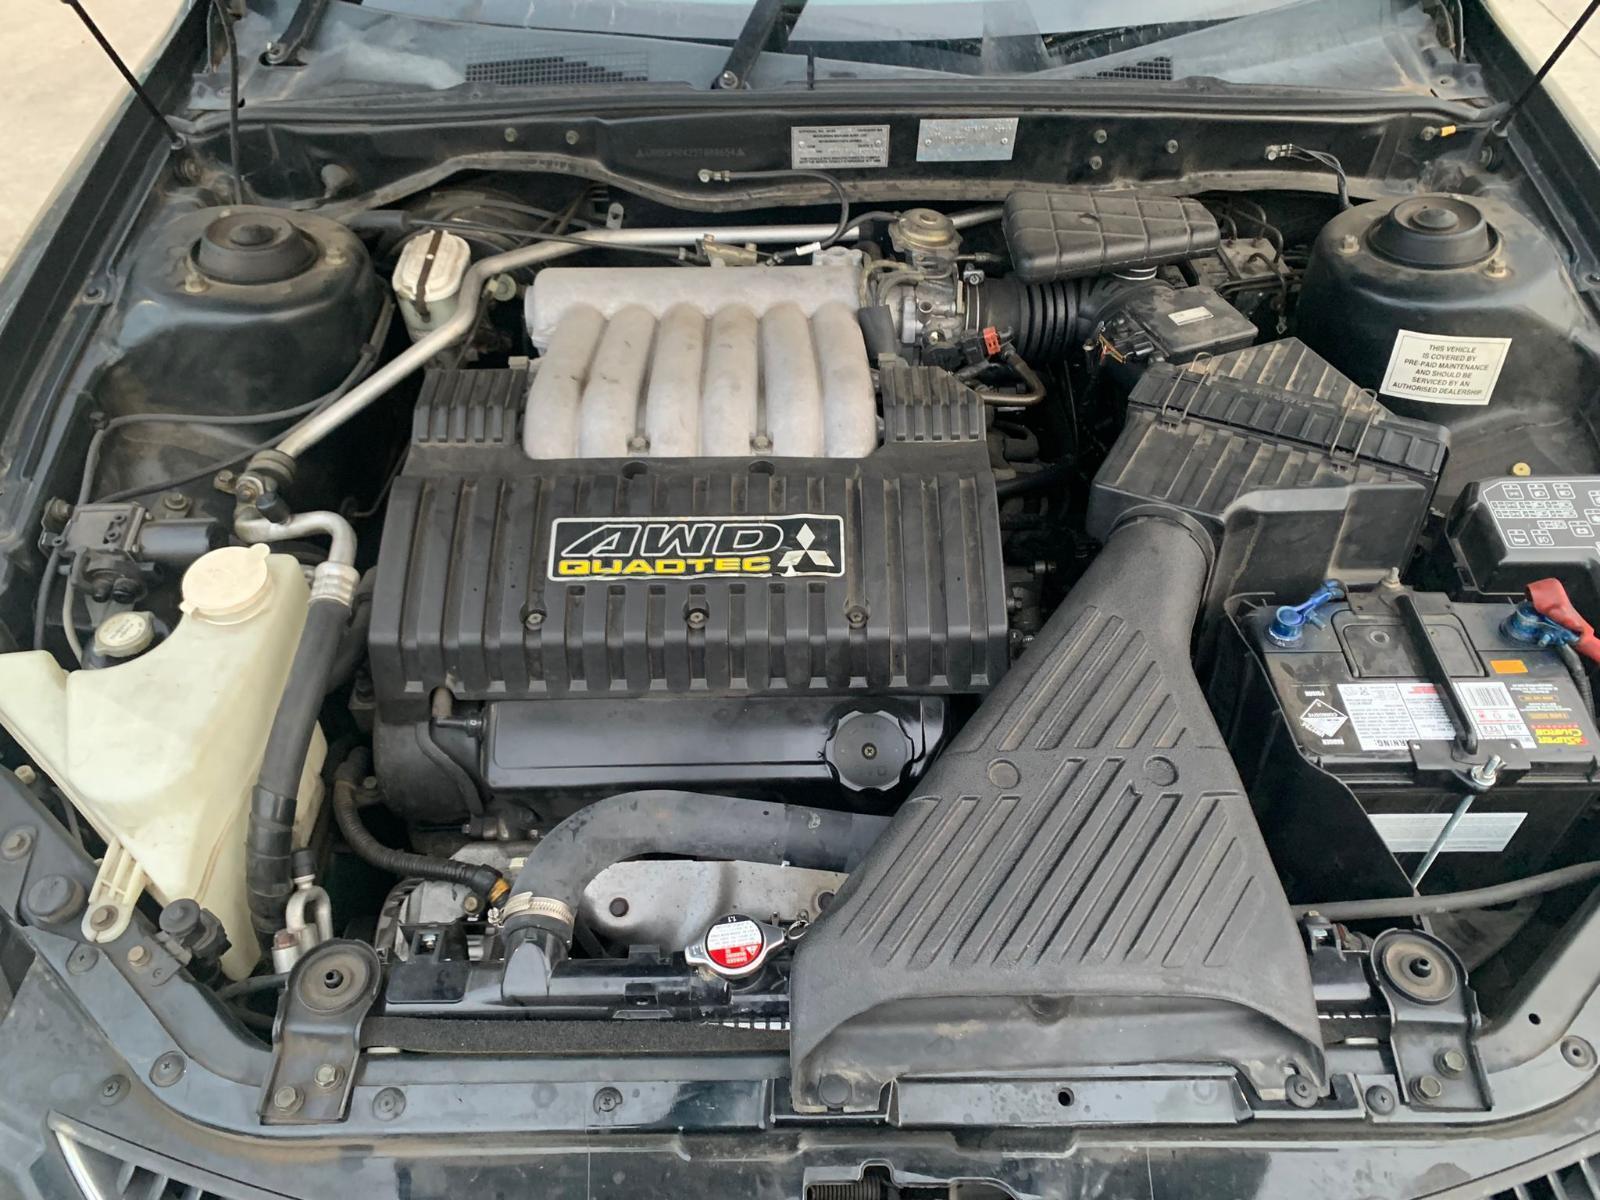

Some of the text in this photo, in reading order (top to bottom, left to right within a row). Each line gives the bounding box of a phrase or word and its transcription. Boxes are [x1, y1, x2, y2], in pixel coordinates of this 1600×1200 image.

[1429, 344, 1477, 354] THIS VEHICLE
[1430, 353, 1466, 362] COVERED
[1404, 358, 1490, 371] PRE-PAID MAINTENANCE
[1415, 369, 1431, 377] AND
[1431, 370, 1461, 378] SHOULD
[1411, 376, 1448, 386] SERVICED
[1392, 381, 1483, 396] AUTHORISED DEALERSHIP
[560, 523, 784, 557] AWD
[558, 556, 772, 575] QUADTEC
[1373, 739, 1407, 748] RNING:
